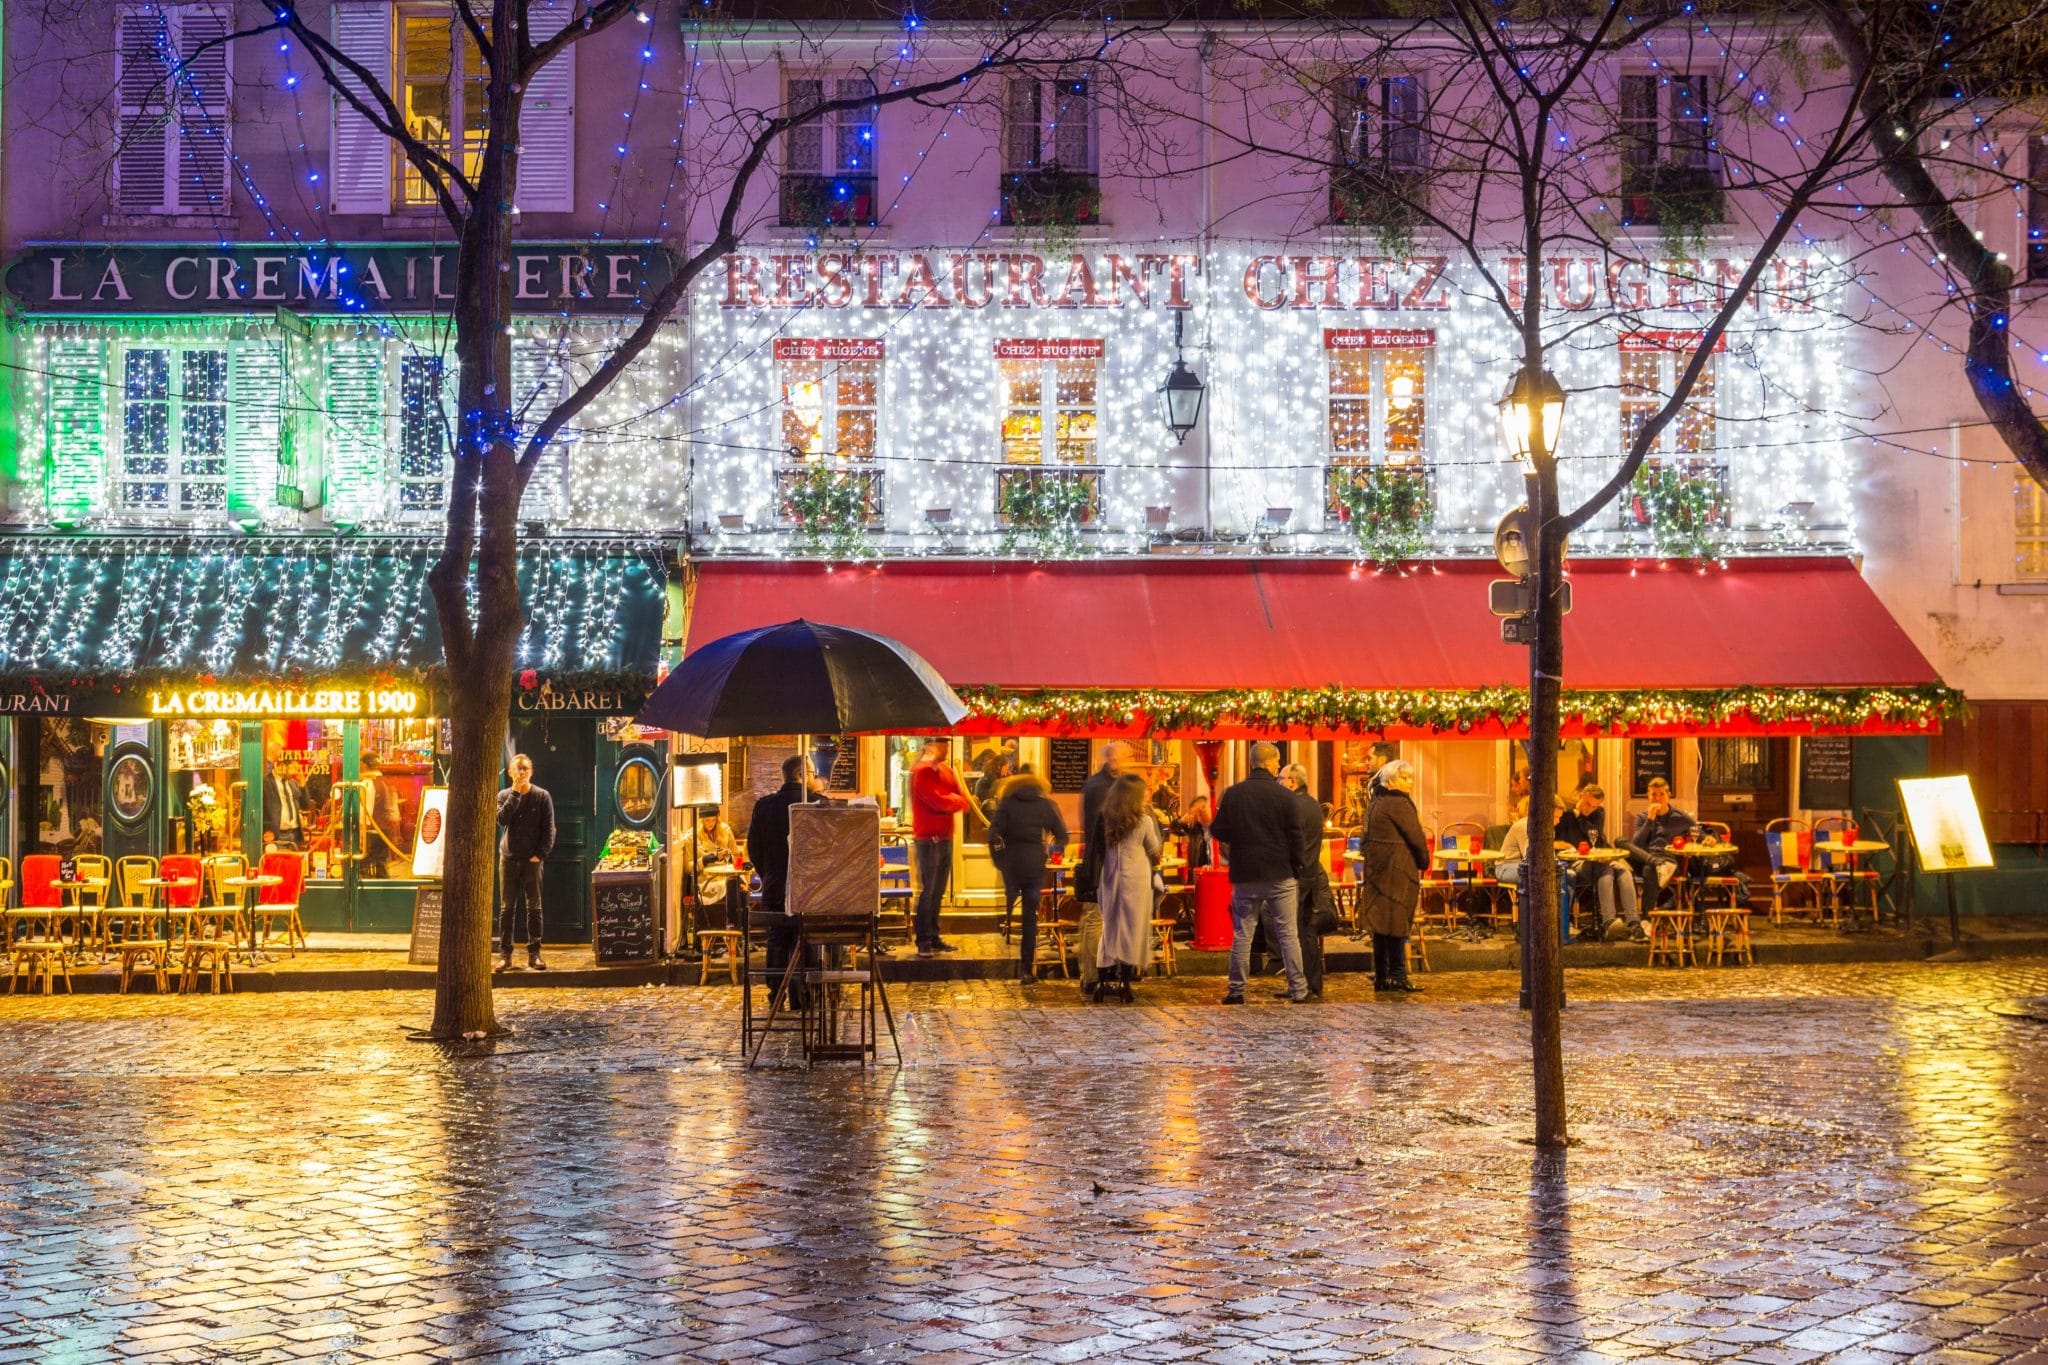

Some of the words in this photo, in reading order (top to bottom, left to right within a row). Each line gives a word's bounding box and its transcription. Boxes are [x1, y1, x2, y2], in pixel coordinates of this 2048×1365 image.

[49, 256, 133, 301] LA
[166, 255, 640, 301] CREMAILERE
[719, 253, 1200, 310] RESTAURANT
[1243, 255, 1452, 311] CHEZ
[1331, 336, 1367, 346] CHEZ
[1373, 335, 1429, 345] EUGENE
[781, 346, 817, 356] CHEZ
[823, 346, 880, 356] EUGENE
[1000, 345, 1035, 356] CHEZ
[1042, 345, 1097, 356] EUGENE
[151, 691, 185, 713] LA
[368, 691, 416, 713] 1900
[518, 691, 623, 710] CABARET
